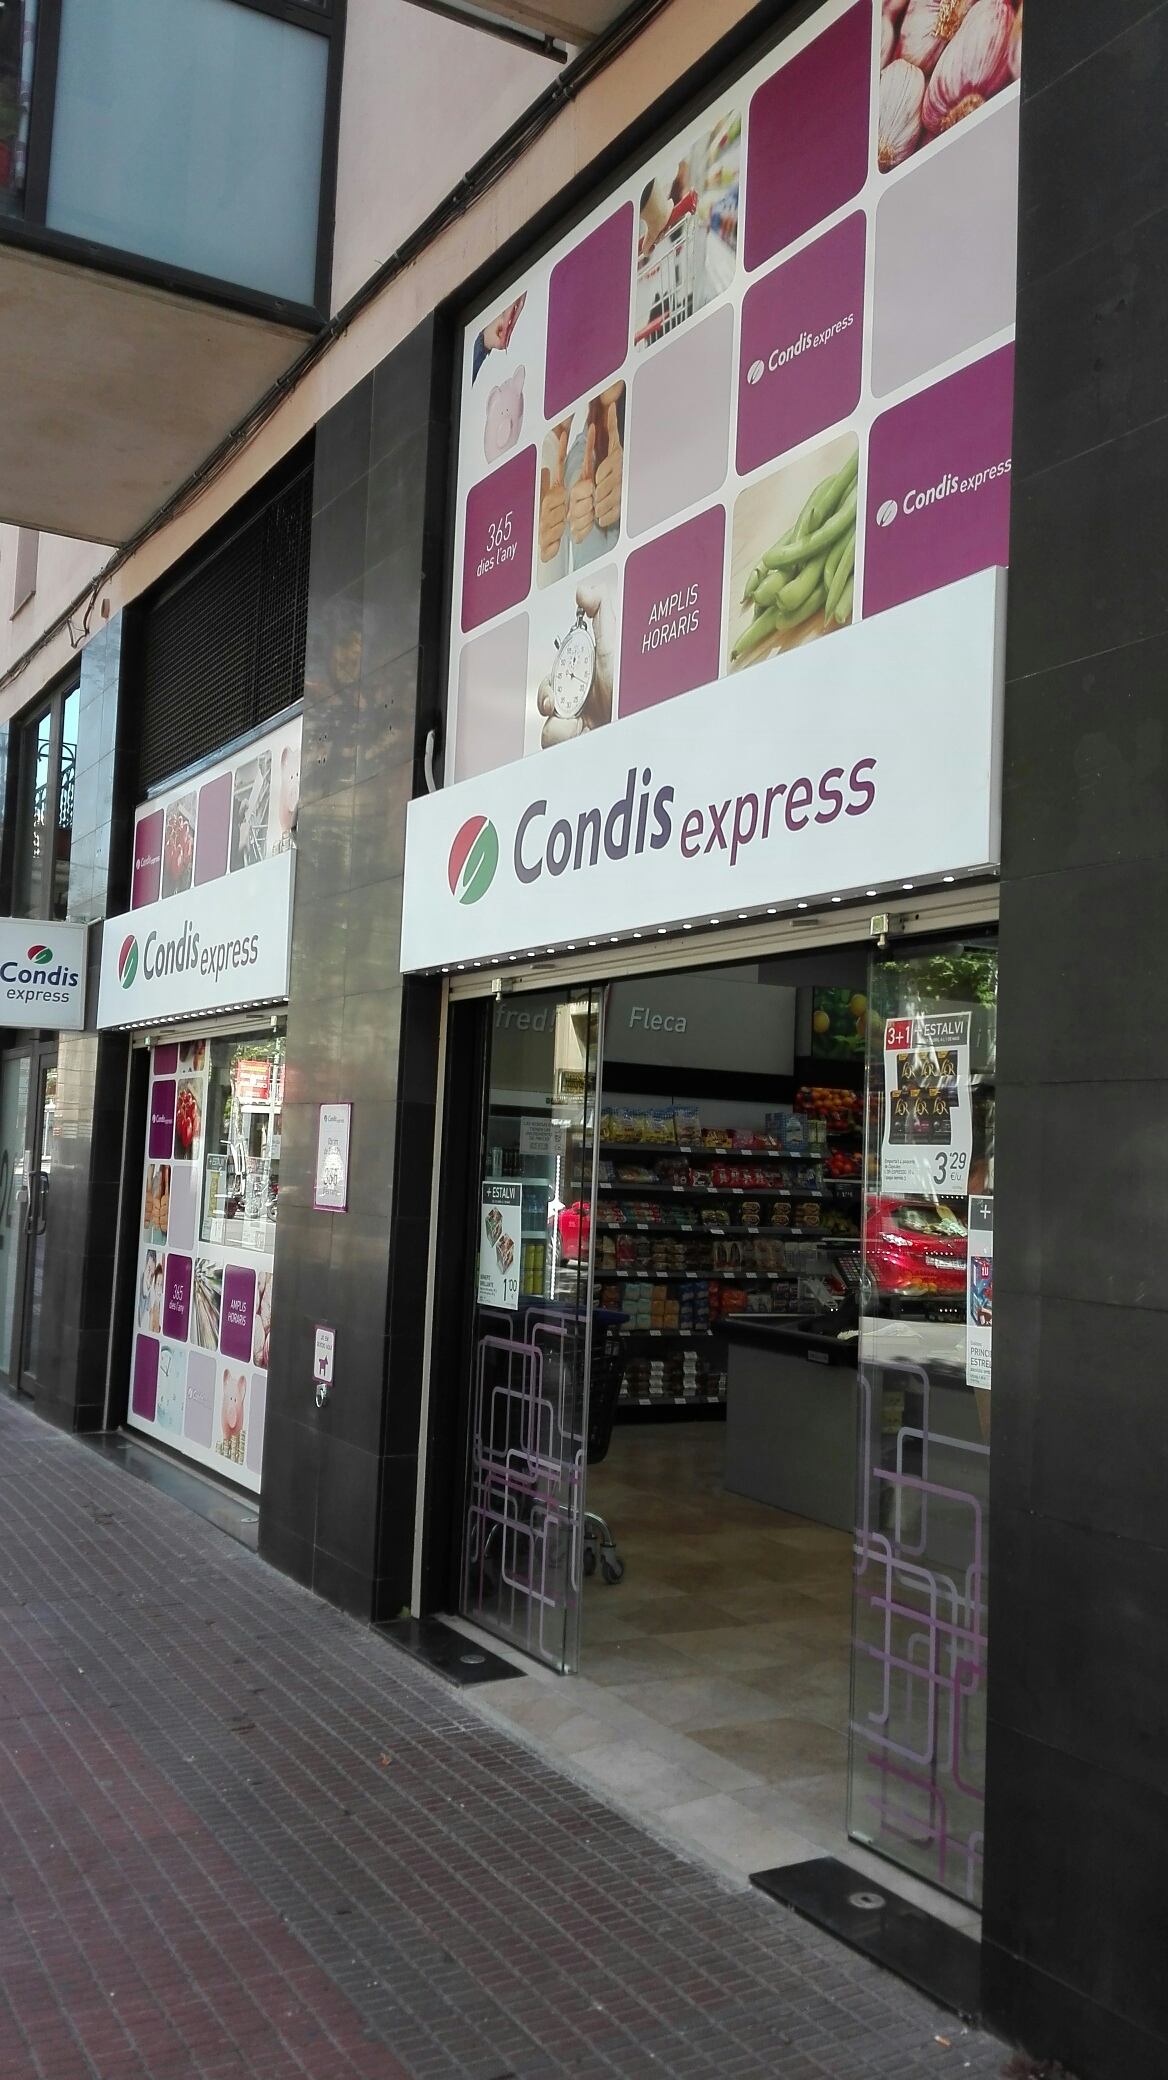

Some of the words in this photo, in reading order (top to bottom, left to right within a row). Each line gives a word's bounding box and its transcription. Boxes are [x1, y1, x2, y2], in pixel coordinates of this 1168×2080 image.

[767, 332, 813, 372] Condis
[812, 313, 854, 348] express
[902, 473, 959, 515] Condis
[959, 458, 1012, 493] express
[486, 511, 513, 552] 365
[476, 551, 495, 577] dies
[496, 541, 518, 565] l'any
[648, 583, 699, 625] AMPLIS
[641, 609, 699, 654] HORARIS
[513, 766, 676, 885] Condis
[679, 757, 878, 867] express
[143, 919, 200, 981] Condis
[200, 934, 259, 983] express
[0, 961, 79, 987] Condis
[6, 986, 70, 1003] express
[628, 1006, 687, 1033] Fleca
[887, 1025, 910, 1045] 3+1
[924, 1021, 963, 1036] ESTALVI
[492, 1186, 516, 1199] ESTALVI
[172, 1283, 184, 1301] 365
[229, 1299, 247, 1313] AMPLIS
[227, 1312, 247, 1326] HORARIS
